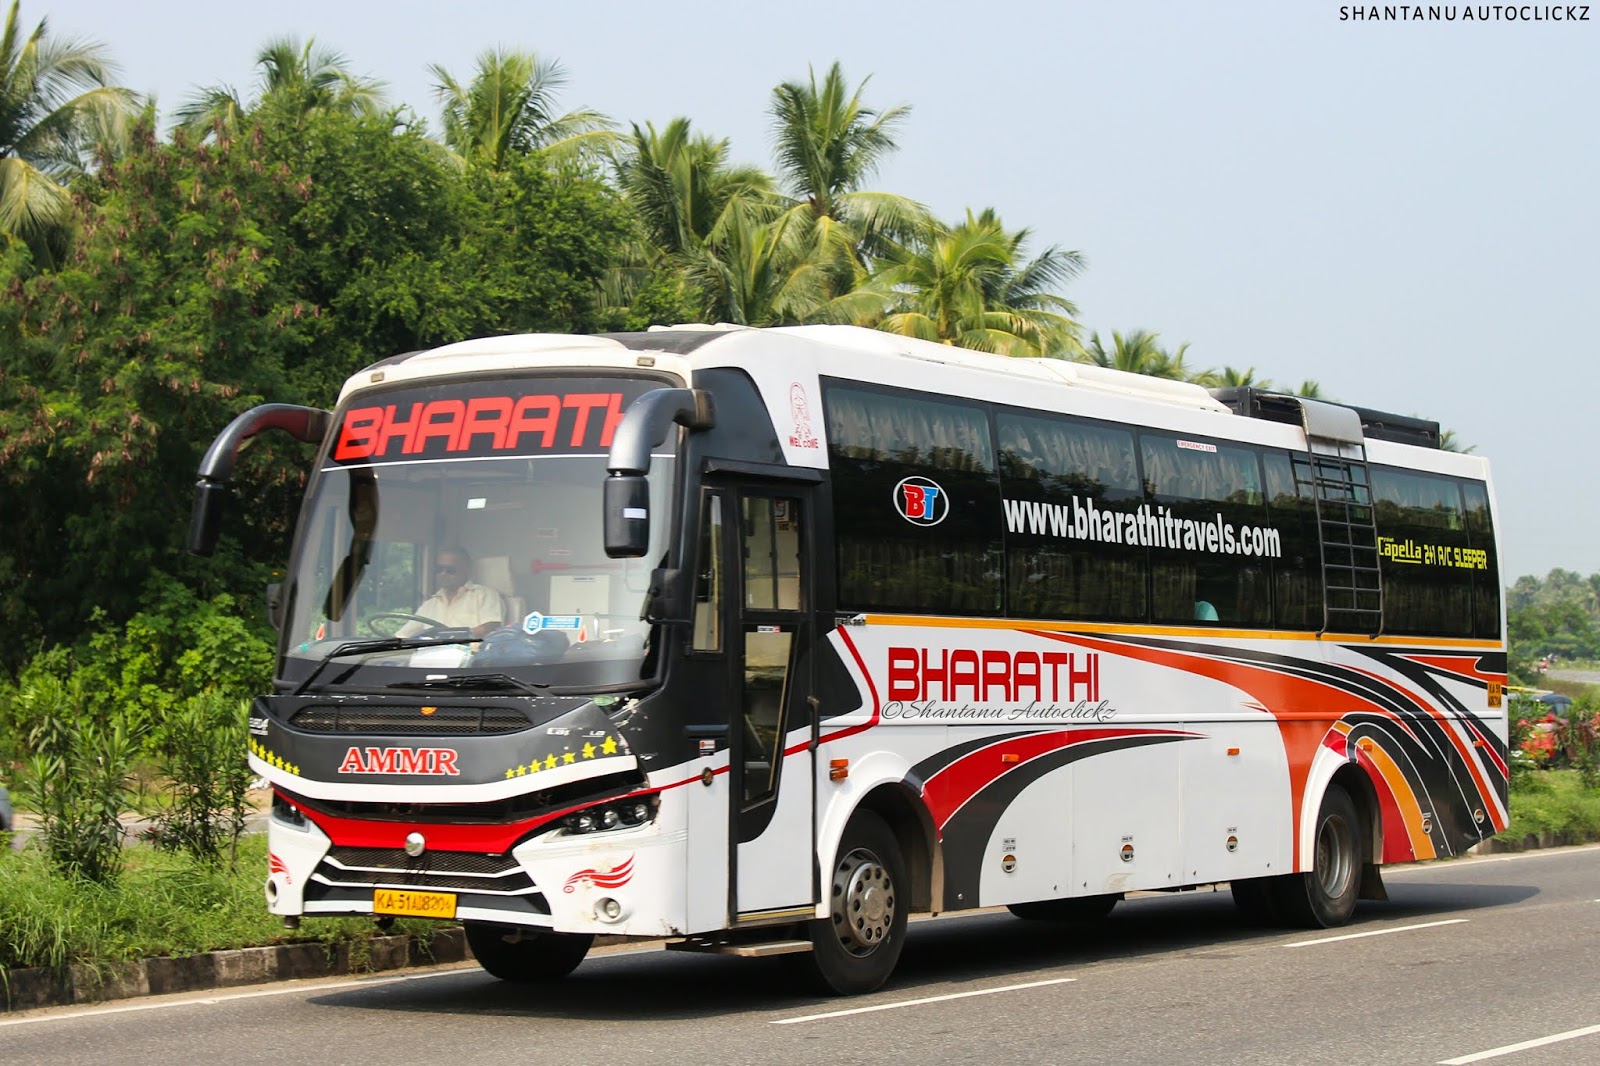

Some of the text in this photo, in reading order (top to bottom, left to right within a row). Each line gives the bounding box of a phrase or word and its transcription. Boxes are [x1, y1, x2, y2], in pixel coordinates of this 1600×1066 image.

[902, 483, 939, 520] BT
[1003, 495, 1281, 558] www.bharathitravels.com
[1378, 537, 1422, 563] Capella
[1454, 547, 1488, 570] SLEEPER
[888, 647, 1099, 702] BHARATHI
[338, 746, 460, 776] AMMR
